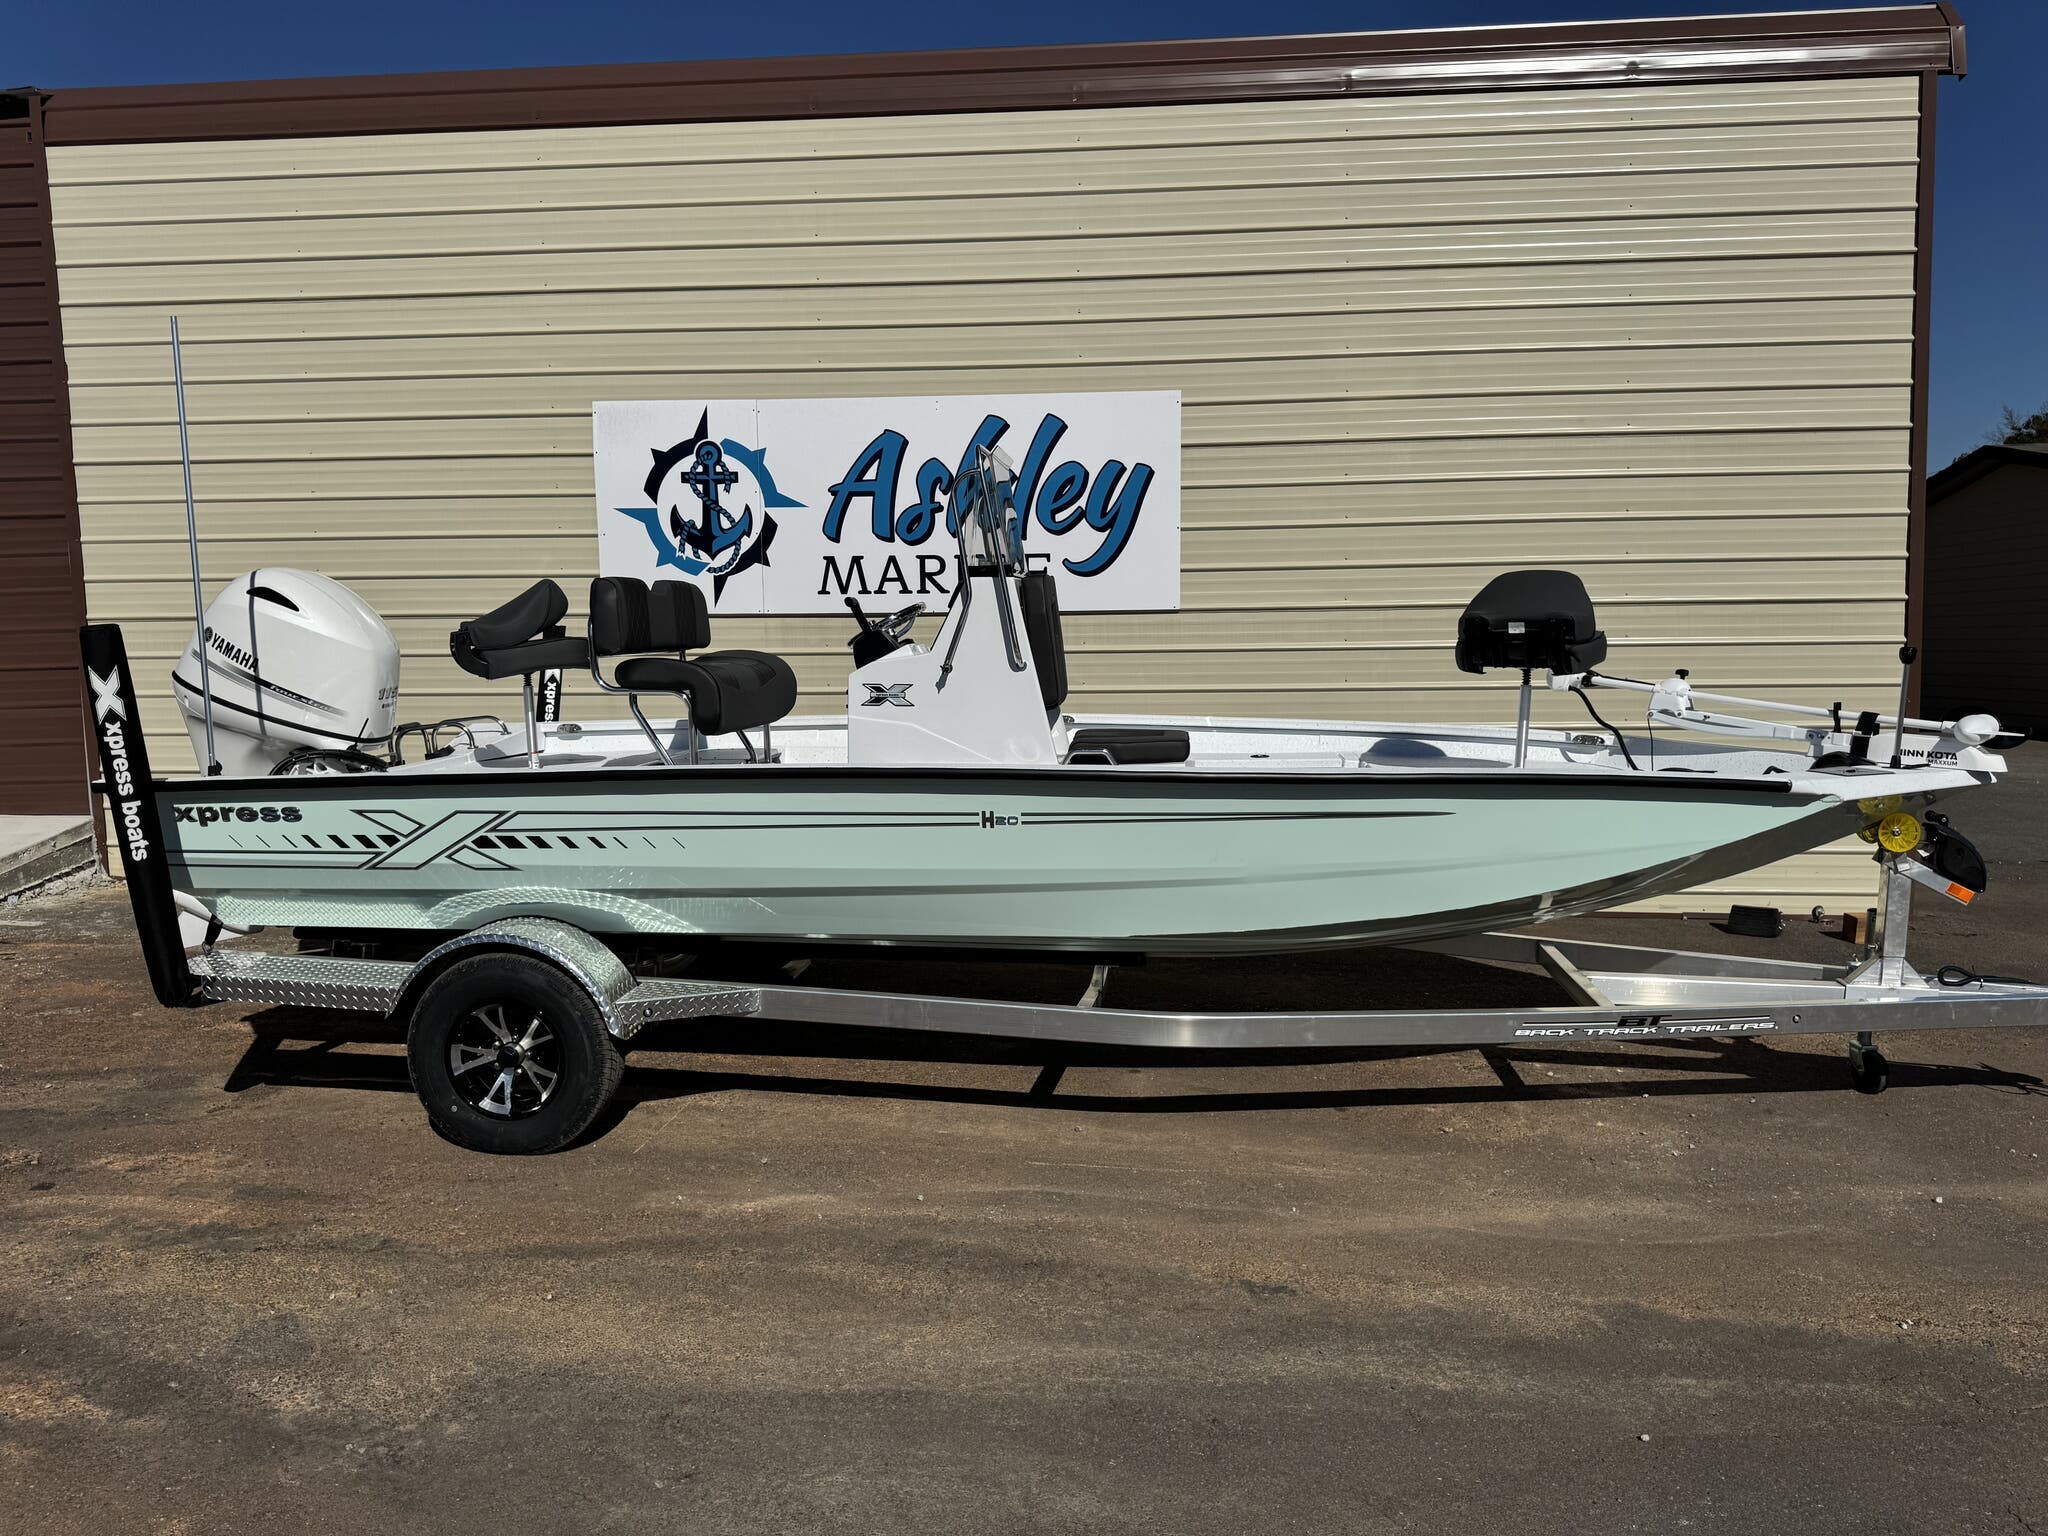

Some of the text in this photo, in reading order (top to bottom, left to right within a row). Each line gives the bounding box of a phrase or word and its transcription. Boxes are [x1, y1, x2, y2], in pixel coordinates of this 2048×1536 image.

[822, 412, 1155, 577] Ashley
[817, 552, 1051, 595] MARE
[211, 632, 259, 674] YAMAHA
[544, 681, 557, 724] xpres
[1926, 750, 1958, 760] KOTA
[1927, 759, 1958, 767] MAXXUM
[103, 721, 134, 797] xpress
[121, 800, 150, 862] boats
[172, 805, 303, 828] xpress
[1514, 1028, 1578, 1037] BACK
[1583, 1026, 1660, 1036] TRACK
[1616, 1014, 1673, 1027] BT
